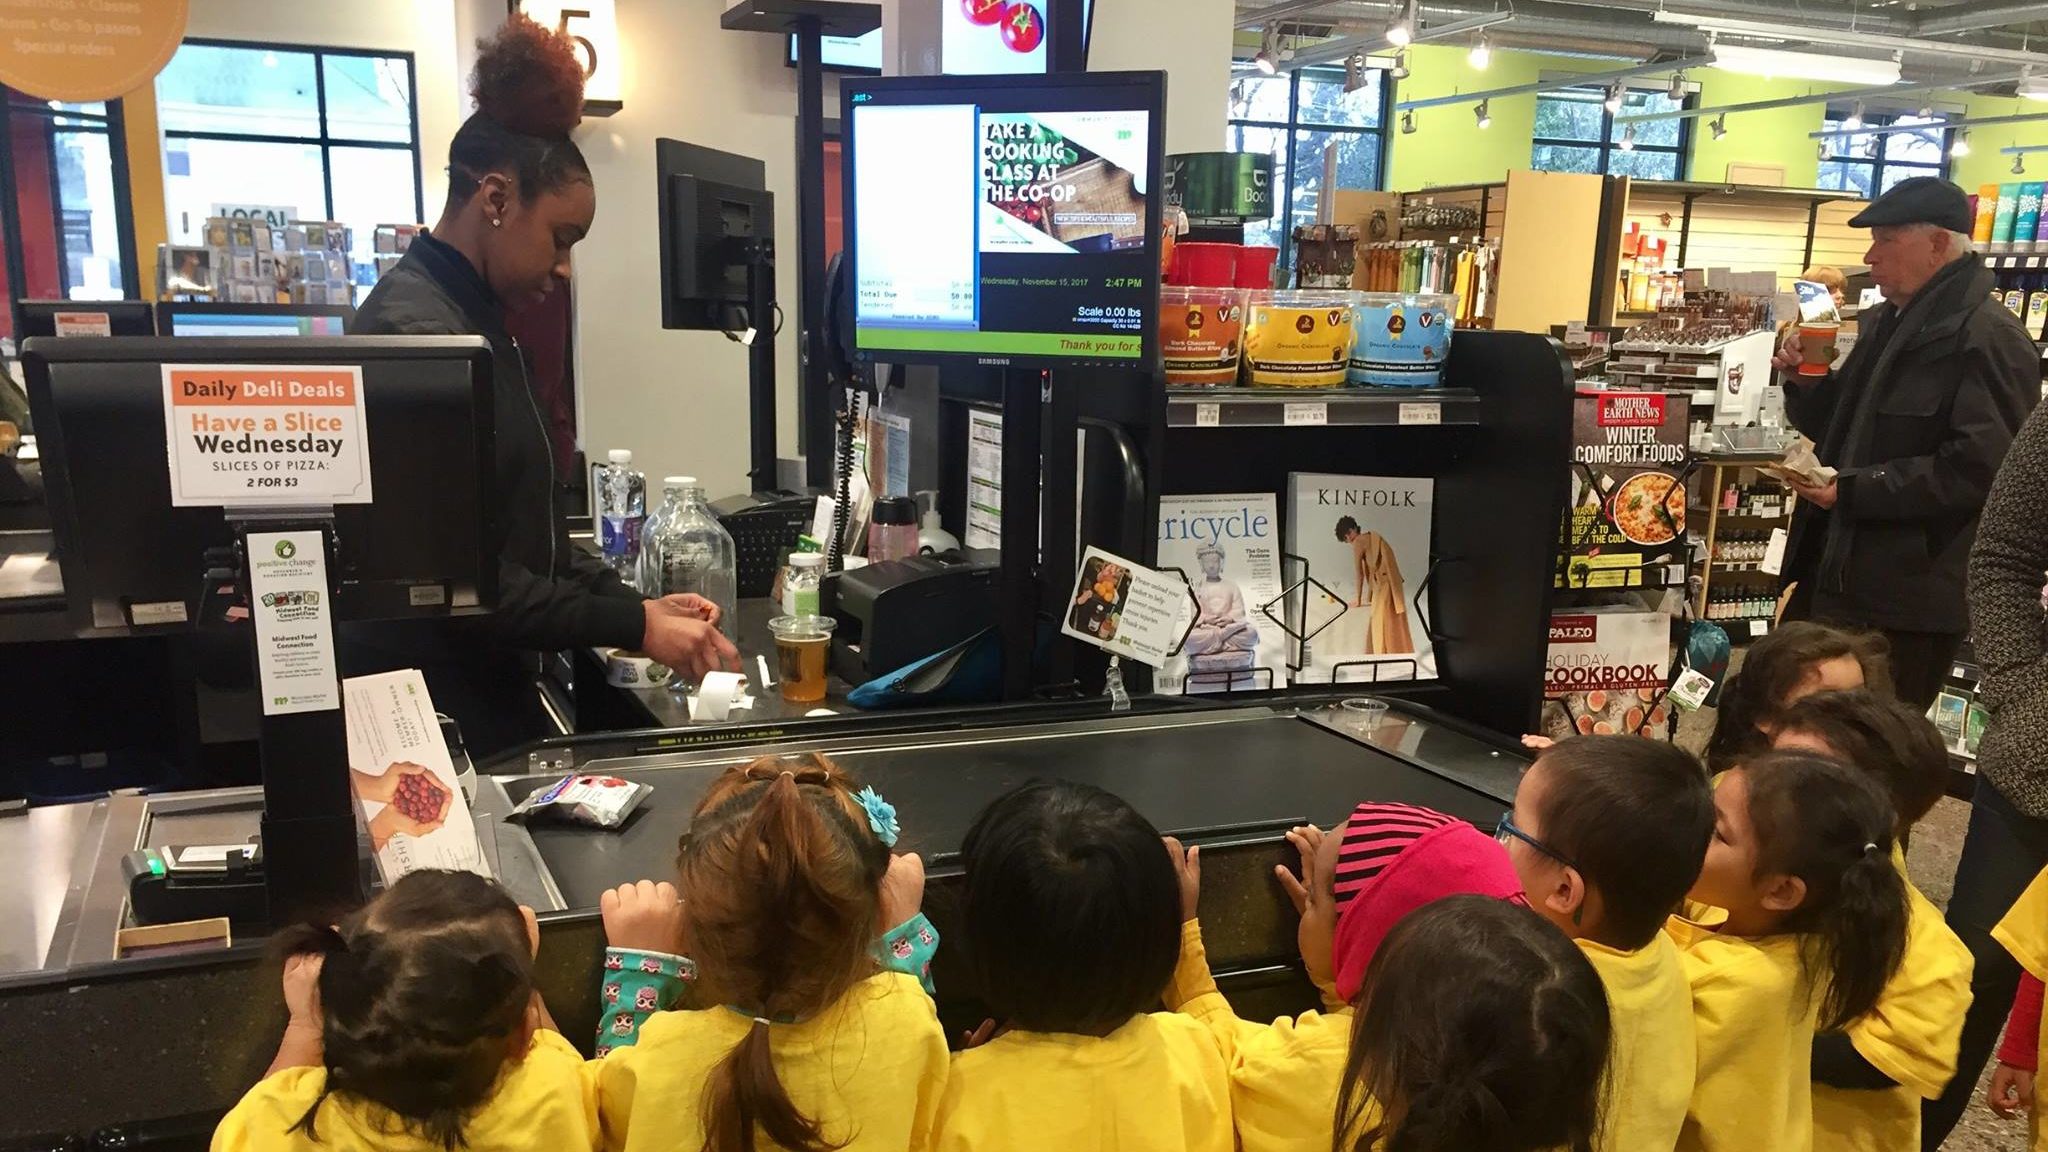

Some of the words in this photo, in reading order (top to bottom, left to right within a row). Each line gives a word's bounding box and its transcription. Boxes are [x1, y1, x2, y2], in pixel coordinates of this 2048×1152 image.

[13, 38, 66, 54] Special
[69, 44, 116, 56] orders
[984, 123, 1025, 139] TAKE
[1029, 123, 1042, 138] A
[984, 142, 1064, 160] COOKING
[984, 164, 1034, 181] CLASS
[1037, 163, 1060, 181] AT
[984, 185, 1014, 201] THE
[1017, 185, 1076, 201] CO-OP
[1022, 278, 1057, 286] November
[1070, 279, 1088, 287] 2017
[1105, 278, 1125, 287] 2:47
[1127, 279, 1142, 287] PM
[860, 290, 880, 298] Total
[1078, 306, 1103, 316] Scale
[1105, 307, 1126, 317] 0.00
[1127, 308, 1141, 317] lbs
[1060, 339, 1092, 350] Thank
[1095, 342, 1116, 352] you
[1118, 341, 1134, 351] for
[183, 380, 237, 400] Daily
[243, 380, 283, 398] Deli
[289, 380, 345, 398] Deals
[1614, 397, 1650, 408] MOTHER
[1604, 408, 1633, 418] EARTH
[1635, 407, 1660, 418] NEWS
[192, 413, 256, 432] Have
[264, 418, 277, 432] a
[284, 411, 342, 432] Slice
[1606, 426, 1656, 444] WINTER
[193, 433, 343, 457] Wednesday
[1576, 444, 1639, 463] COMFORT
[1642, 444, 1684, 462] FOODS
[213, 461, 258, 471] SLICES
[264, 460, 280, 471] OF
[287, 460, 330, 471] PIZZA:
[247, 478, 254, 487] 2
[258, 478, 282, 487] FOR
[285, 477, 298, 487] $3
[1318, 488, 1416, 507] KINFOLK
[1573, 506, 1597, 516] WARM
[1158, 507, 1268, 547] ricycle
[1572, 525, 1597, 535] MEAS
[1600, 525, 1608, 533] TO
[1592, 535, 1606, 544] THE
[1608, 535, 1626, 543] COLD
[256, 560, 287, 569] positive
[289, 559, 316, 567] change
[1136, 576, 1151, 586] Please
[1122, 617, 1138, 628] Thank
[1549, 627, 1592, 639] PALEO
[1545, 664, 1659, 684] COOKBOOK
